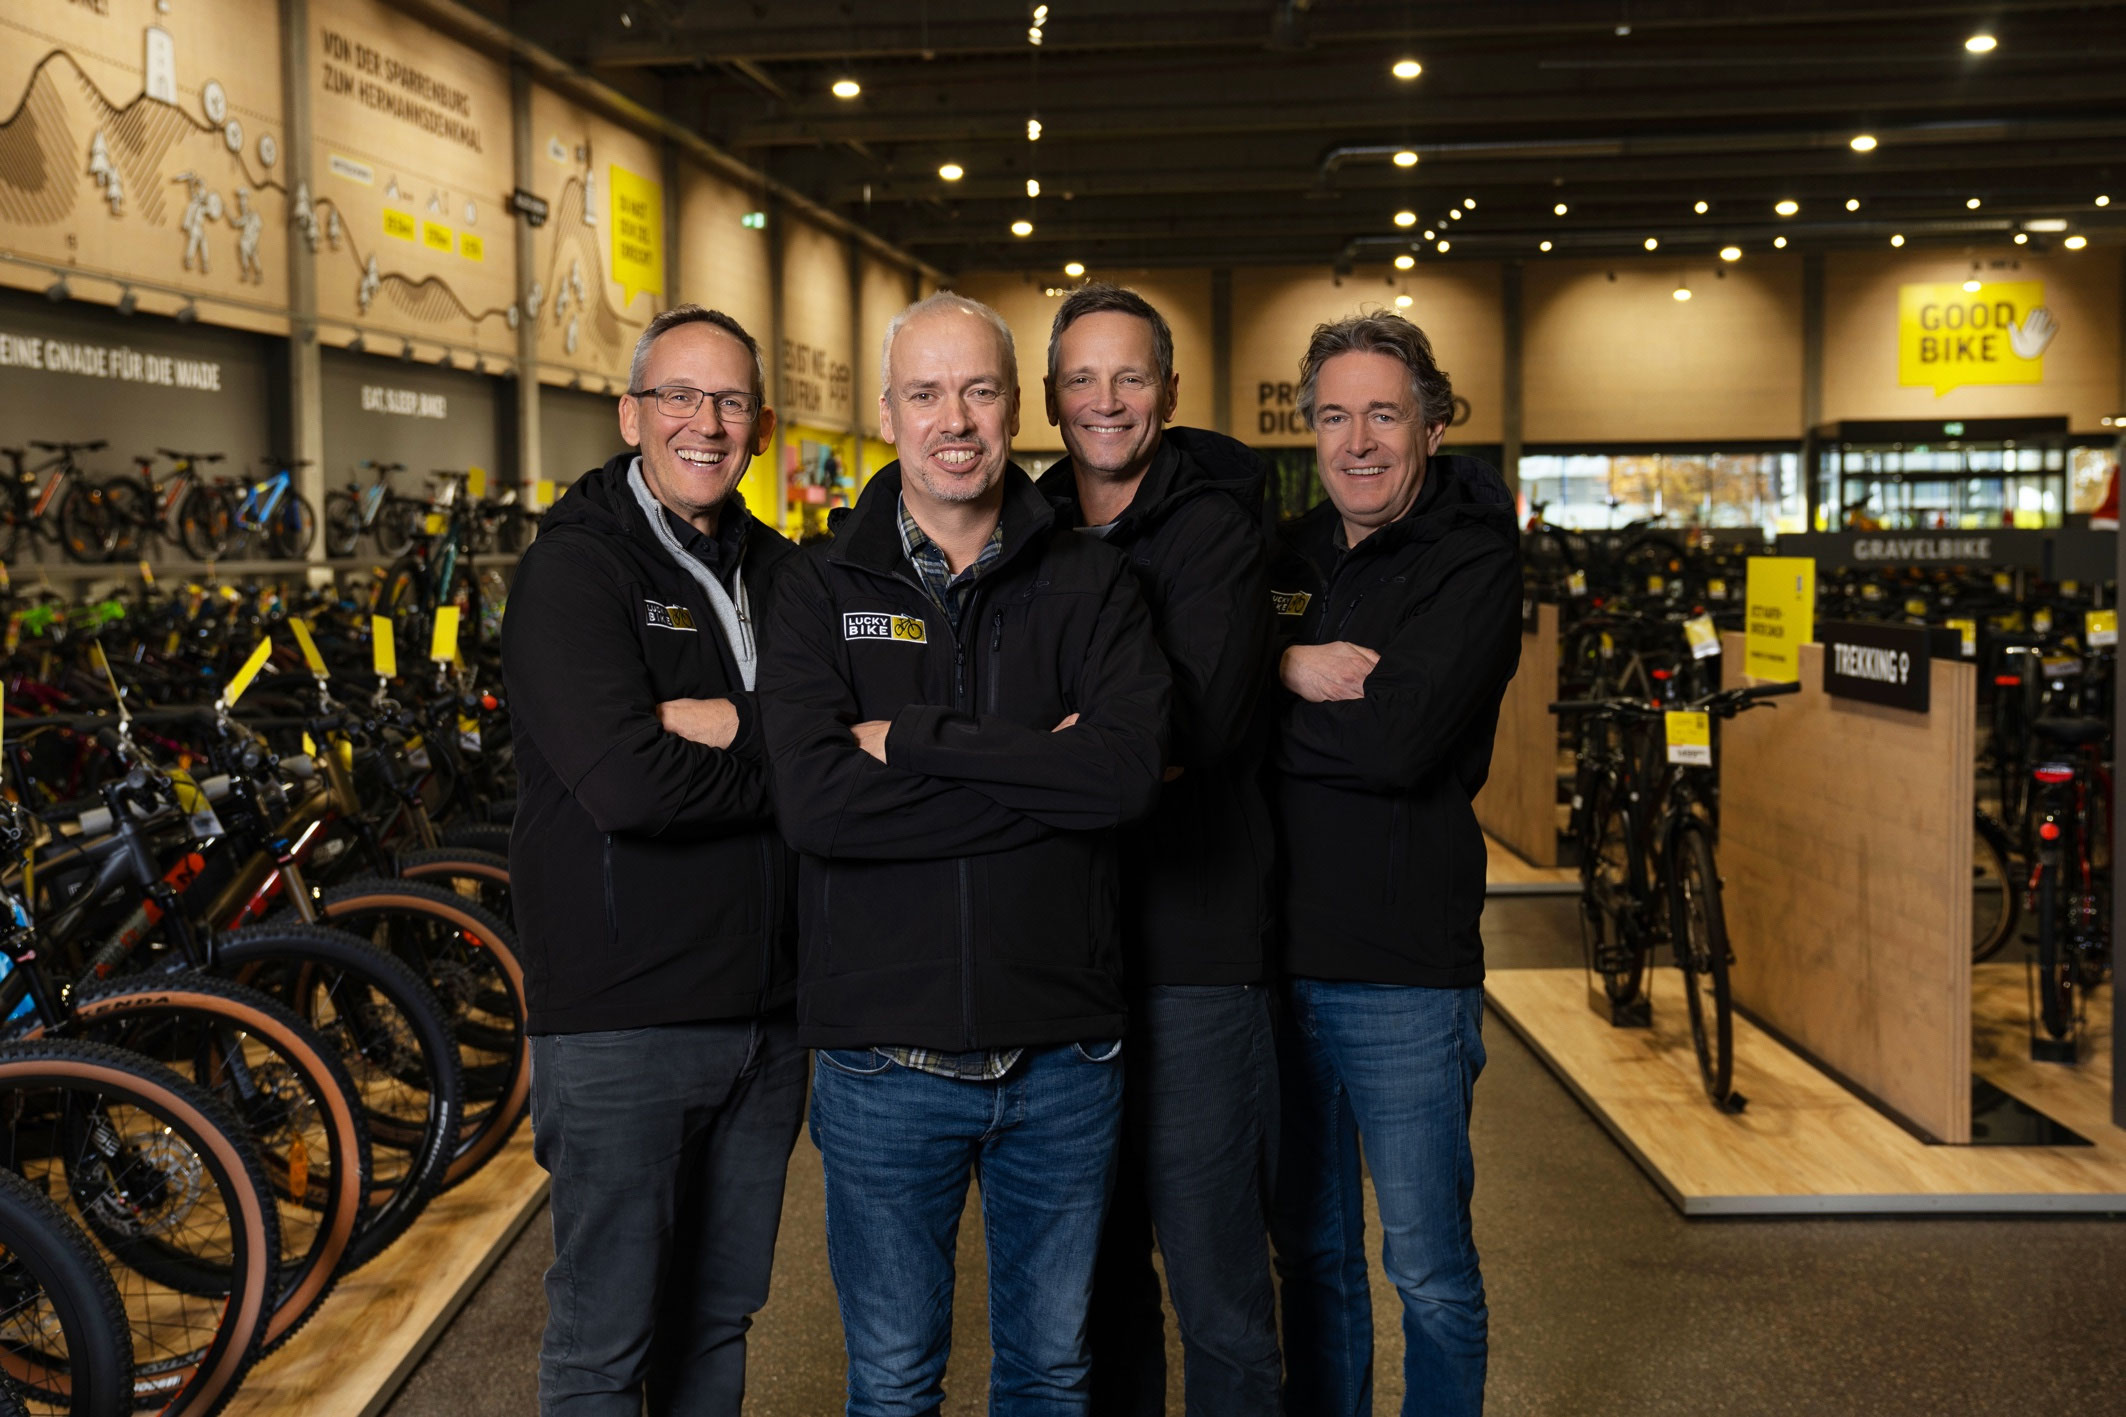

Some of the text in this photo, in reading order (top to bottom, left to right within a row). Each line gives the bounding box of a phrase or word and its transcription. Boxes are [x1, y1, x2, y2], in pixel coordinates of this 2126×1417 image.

[322, 28, 350, 63] VON
[355, 42, 380, 77] DER
[322, 62, 354, 95] ZUM
[1921, 301, 2016, 331] GOOD
[1920, 336, 1999, 363] BIKE
[44, 339, 108, 378] GNADE
[108, 345, 144, 382] FÜR
[144, 353, 174, 386] DIE
[173, 360, 221, 391] WADE
[1258, 382, 1299, 406] PR
[1853, 539, 1992, 560] GRAVELBIKE
[648, 612, 674, 626] BIKE
[848, 616, 888, 626] LUCKY
[849, 625, 889, 636] BIKE
[1834, 642, 1898, 684] TREKKING
